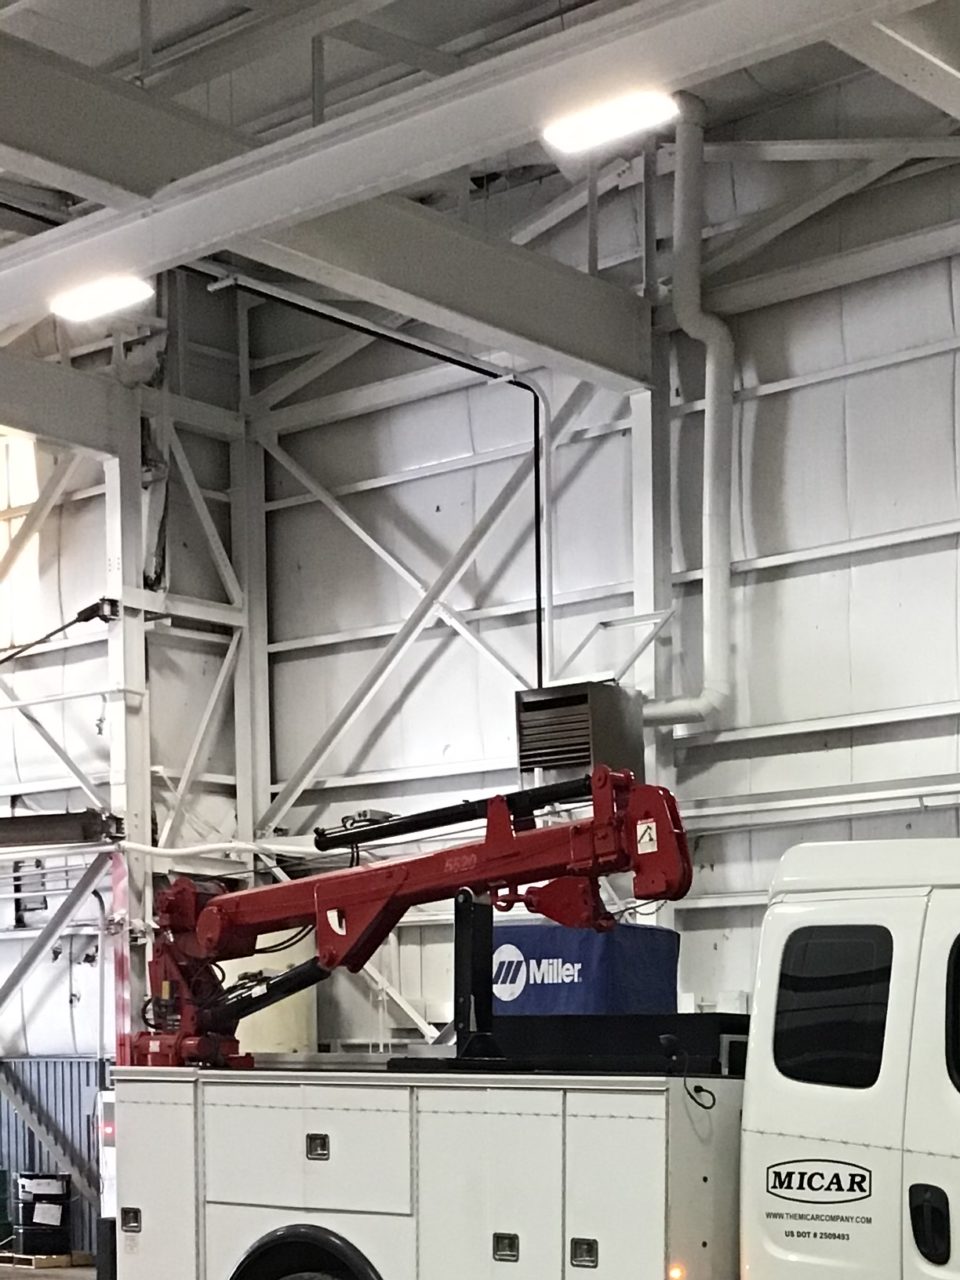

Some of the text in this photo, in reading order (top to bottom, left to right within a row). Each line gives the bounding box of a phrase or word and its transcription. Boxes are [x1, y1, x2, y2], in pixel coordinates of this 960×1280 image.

[529, 958, 582, 984] Miller
[770, 1170, 867, 1193] MICAR
[765, 1211, 872, 1224] WWW.THEMICARCOMPANY.COM
[784, 1230, 795, 1238] US
[796, 1231, 811, 1239] DOT
